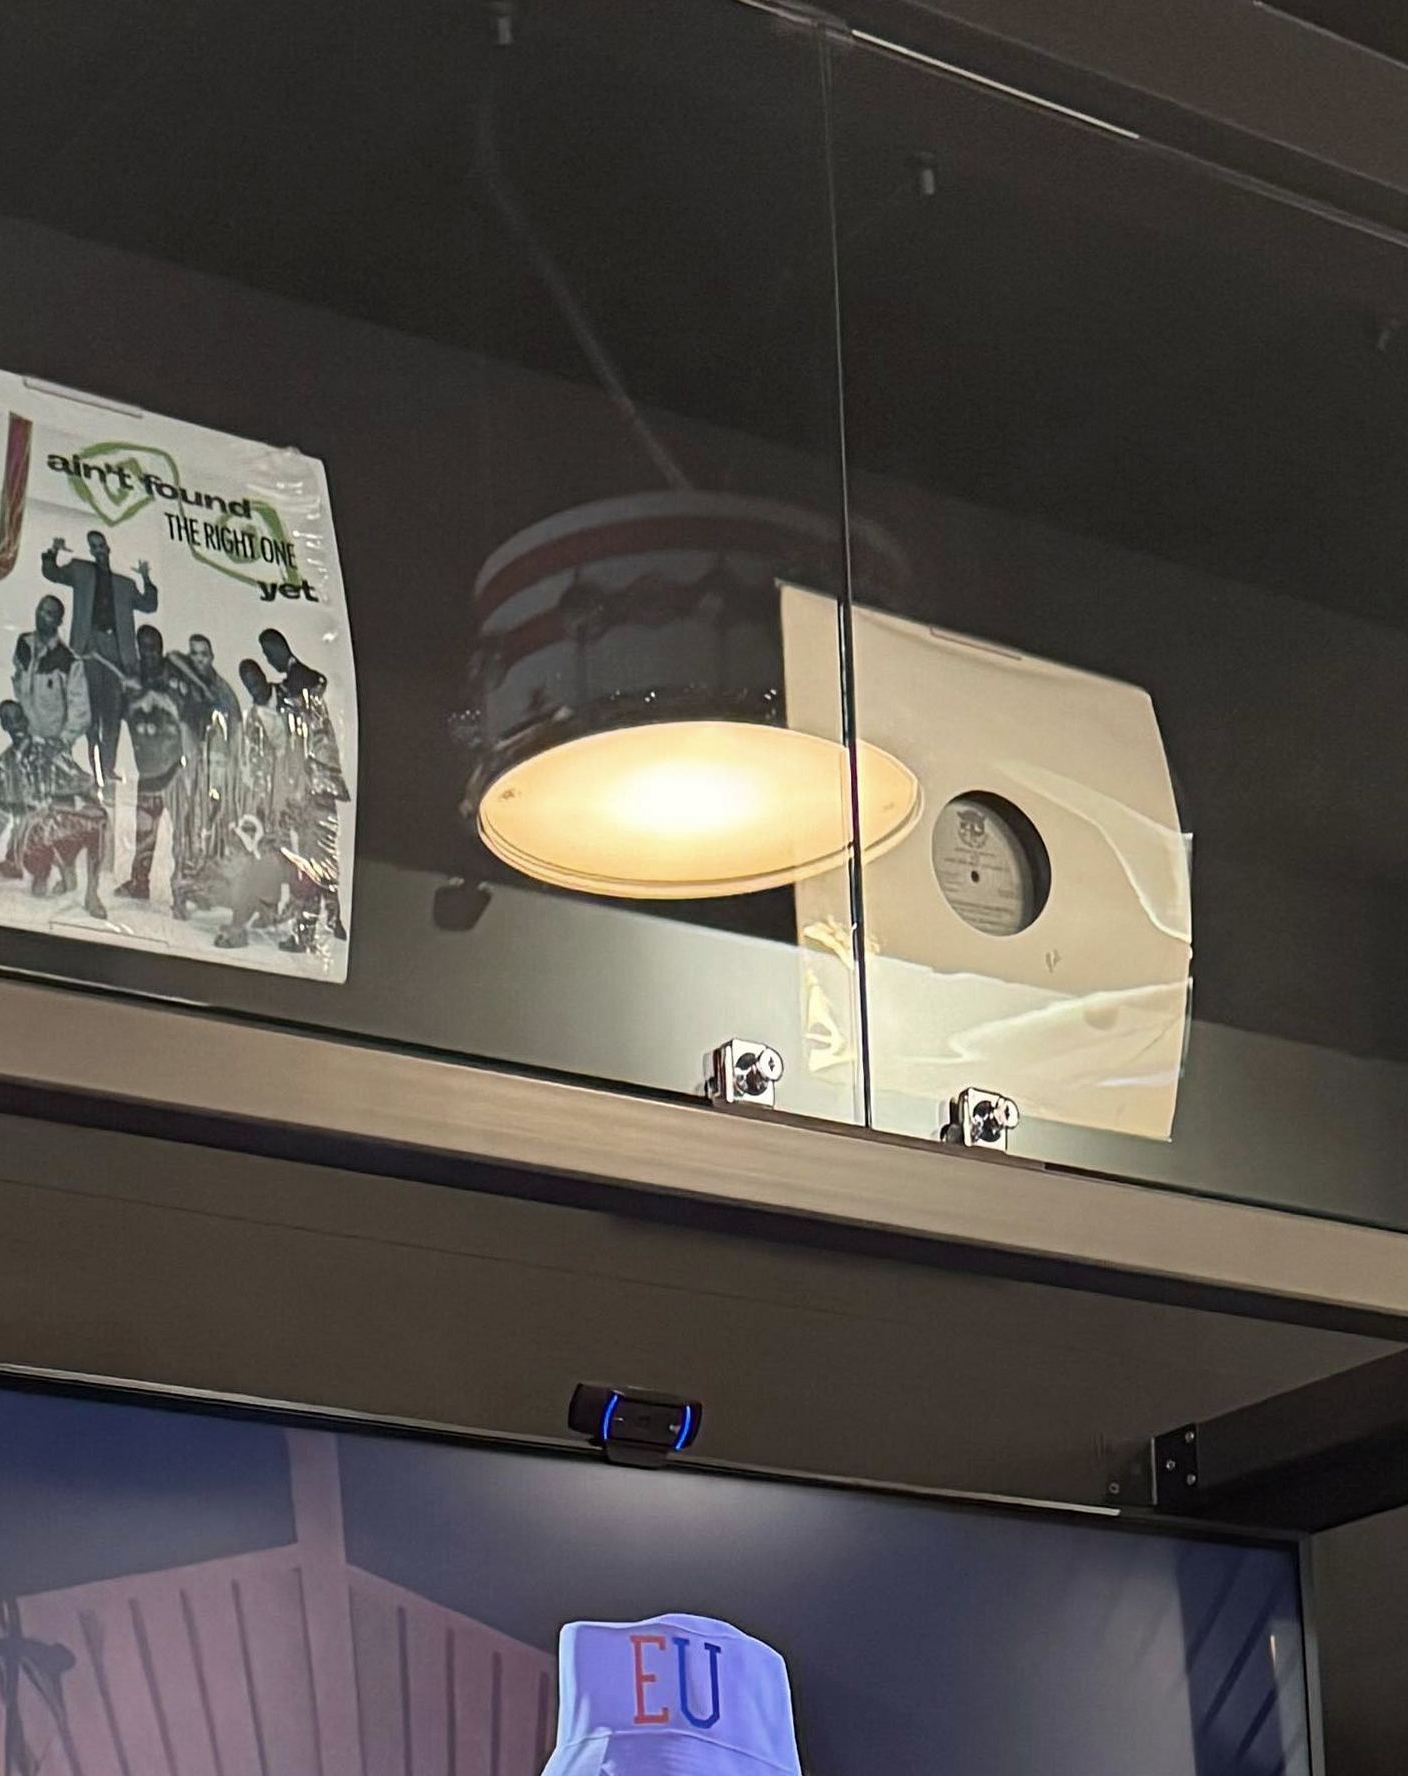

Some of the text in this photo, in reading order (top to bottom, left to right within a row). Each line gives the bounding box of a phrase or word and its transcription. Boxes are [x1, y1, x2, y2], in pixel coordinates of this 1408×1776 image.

[142, 473, 251, 521] found
[164, 511, 296, 569] THE RIGHT ONE
[258, 578, 319, 603] yet
[629, 1634, 722, 1729] EU
